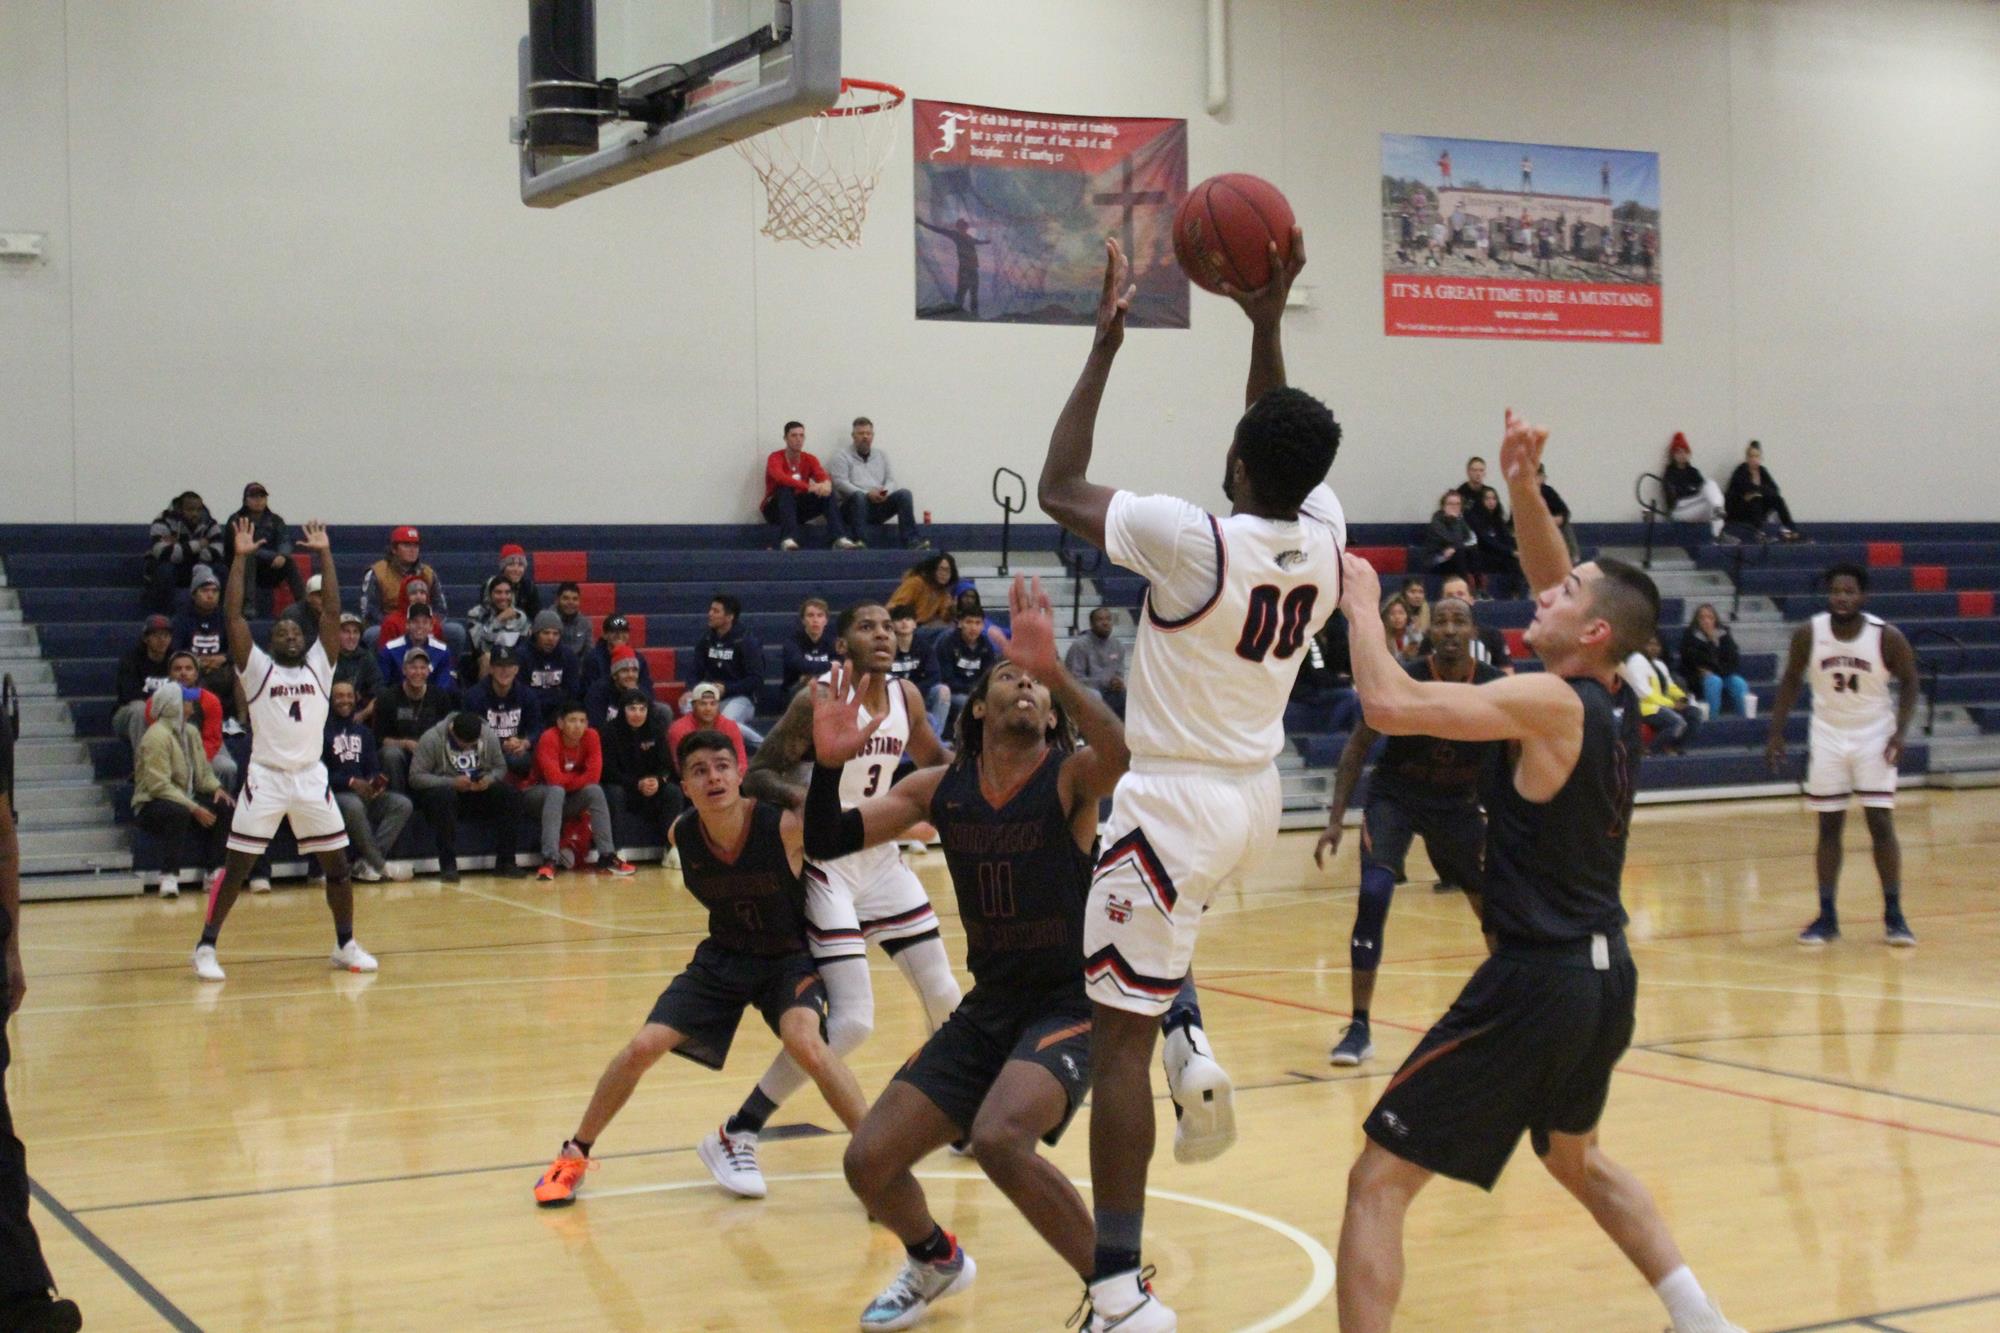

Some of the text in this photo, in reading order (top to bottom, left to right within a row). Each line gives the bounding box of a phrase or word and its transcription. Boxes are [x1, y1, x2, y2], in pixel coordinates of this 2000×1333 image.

[1423, 285, 1434, 299] A
[1436, 284, 1485, 301] GREAT
[1488, 287, 1523, 302] TIME
[1526, 288, 1545, 303] TO
[1547, 289, 1565, 304] BE
[1568, 291, 1579, 304] A
[1833, 672, 1859, 693] 34
[289, 700, 302, 722] 4
[864, 764, 882, 798] 3
[979, 861, 1015, 917] 11
